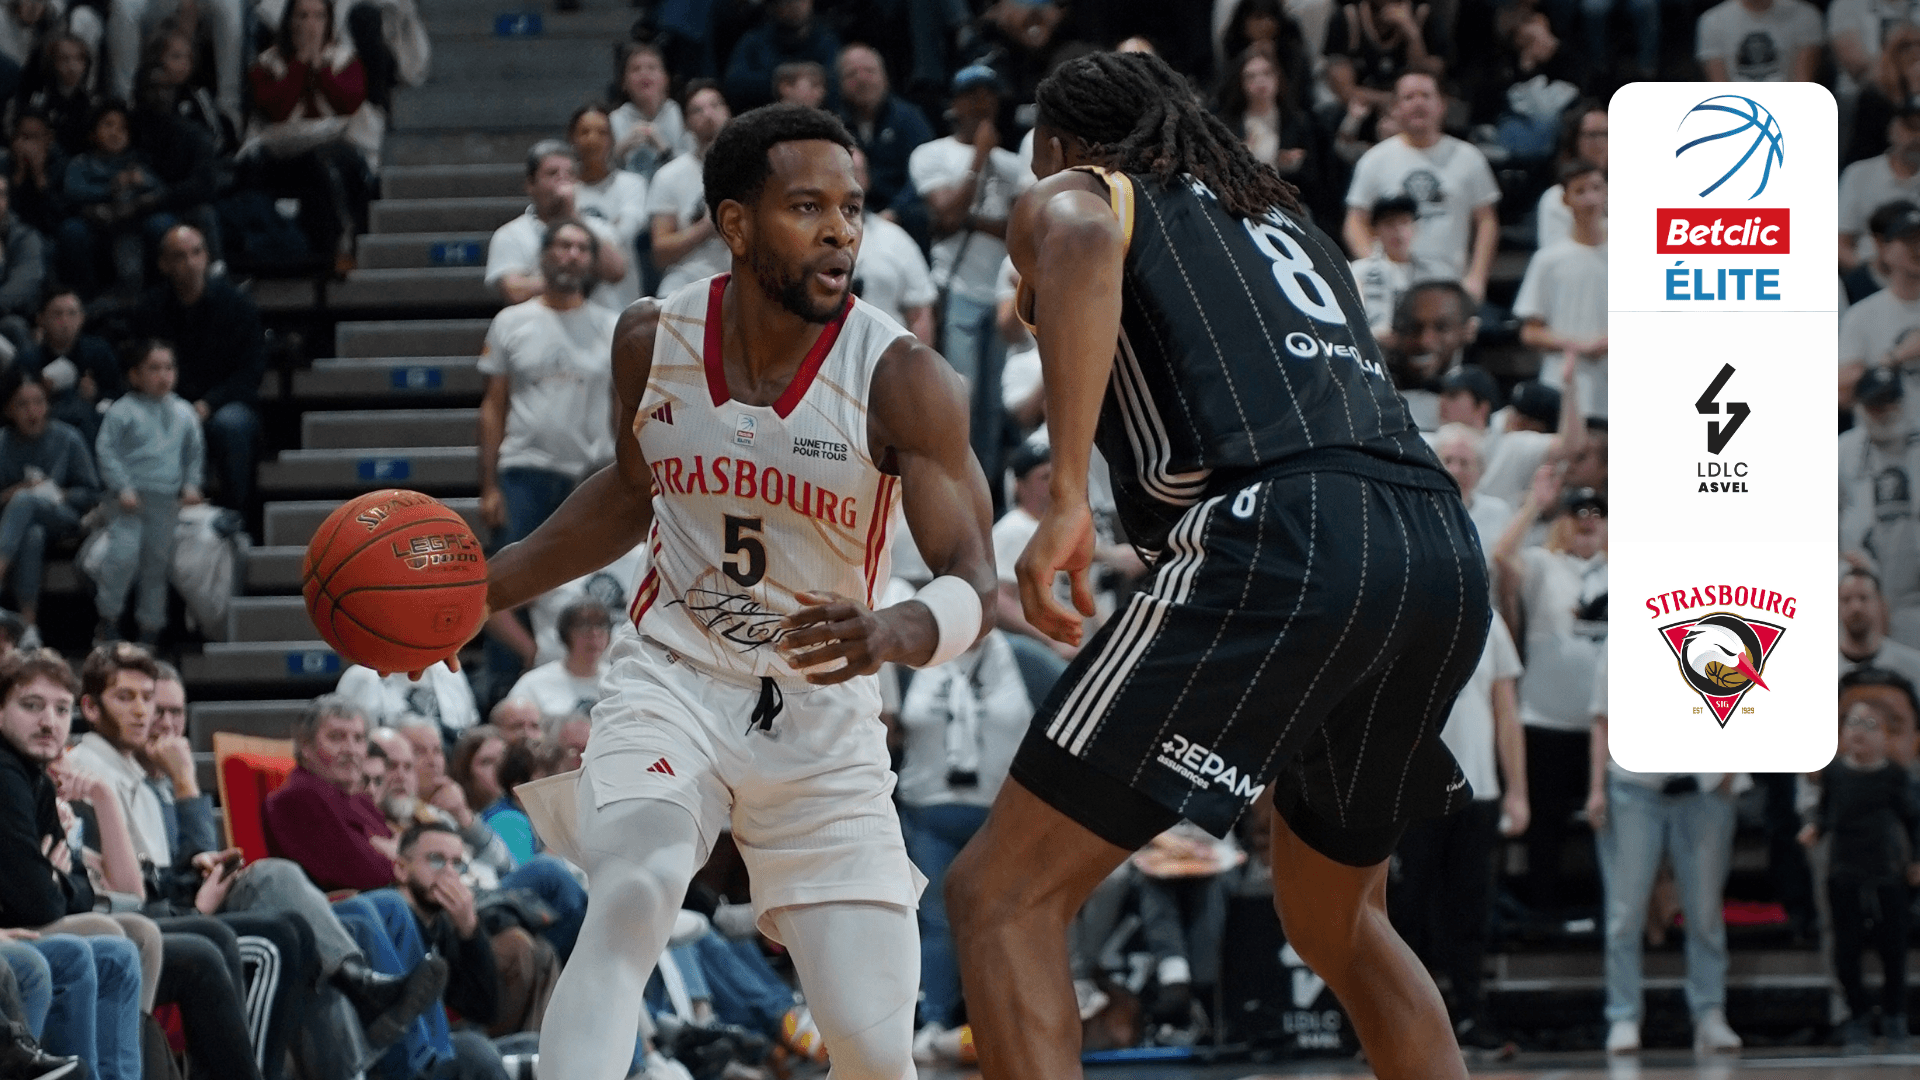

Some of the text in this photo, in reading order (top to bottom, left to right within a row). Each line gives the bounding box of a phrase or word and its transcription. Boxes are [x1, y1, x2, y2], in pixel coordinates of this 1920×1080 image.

[1242, 217, 1347, 324] 8
[793, 446, 847, 461] POUR TOUS
[794, 436, 848, 453] LUNETTES
[722, 513, 767, 588] 5
[1156, 754, 1210, 790] assurances
[1161, 733, 1266, 805] REPAM
